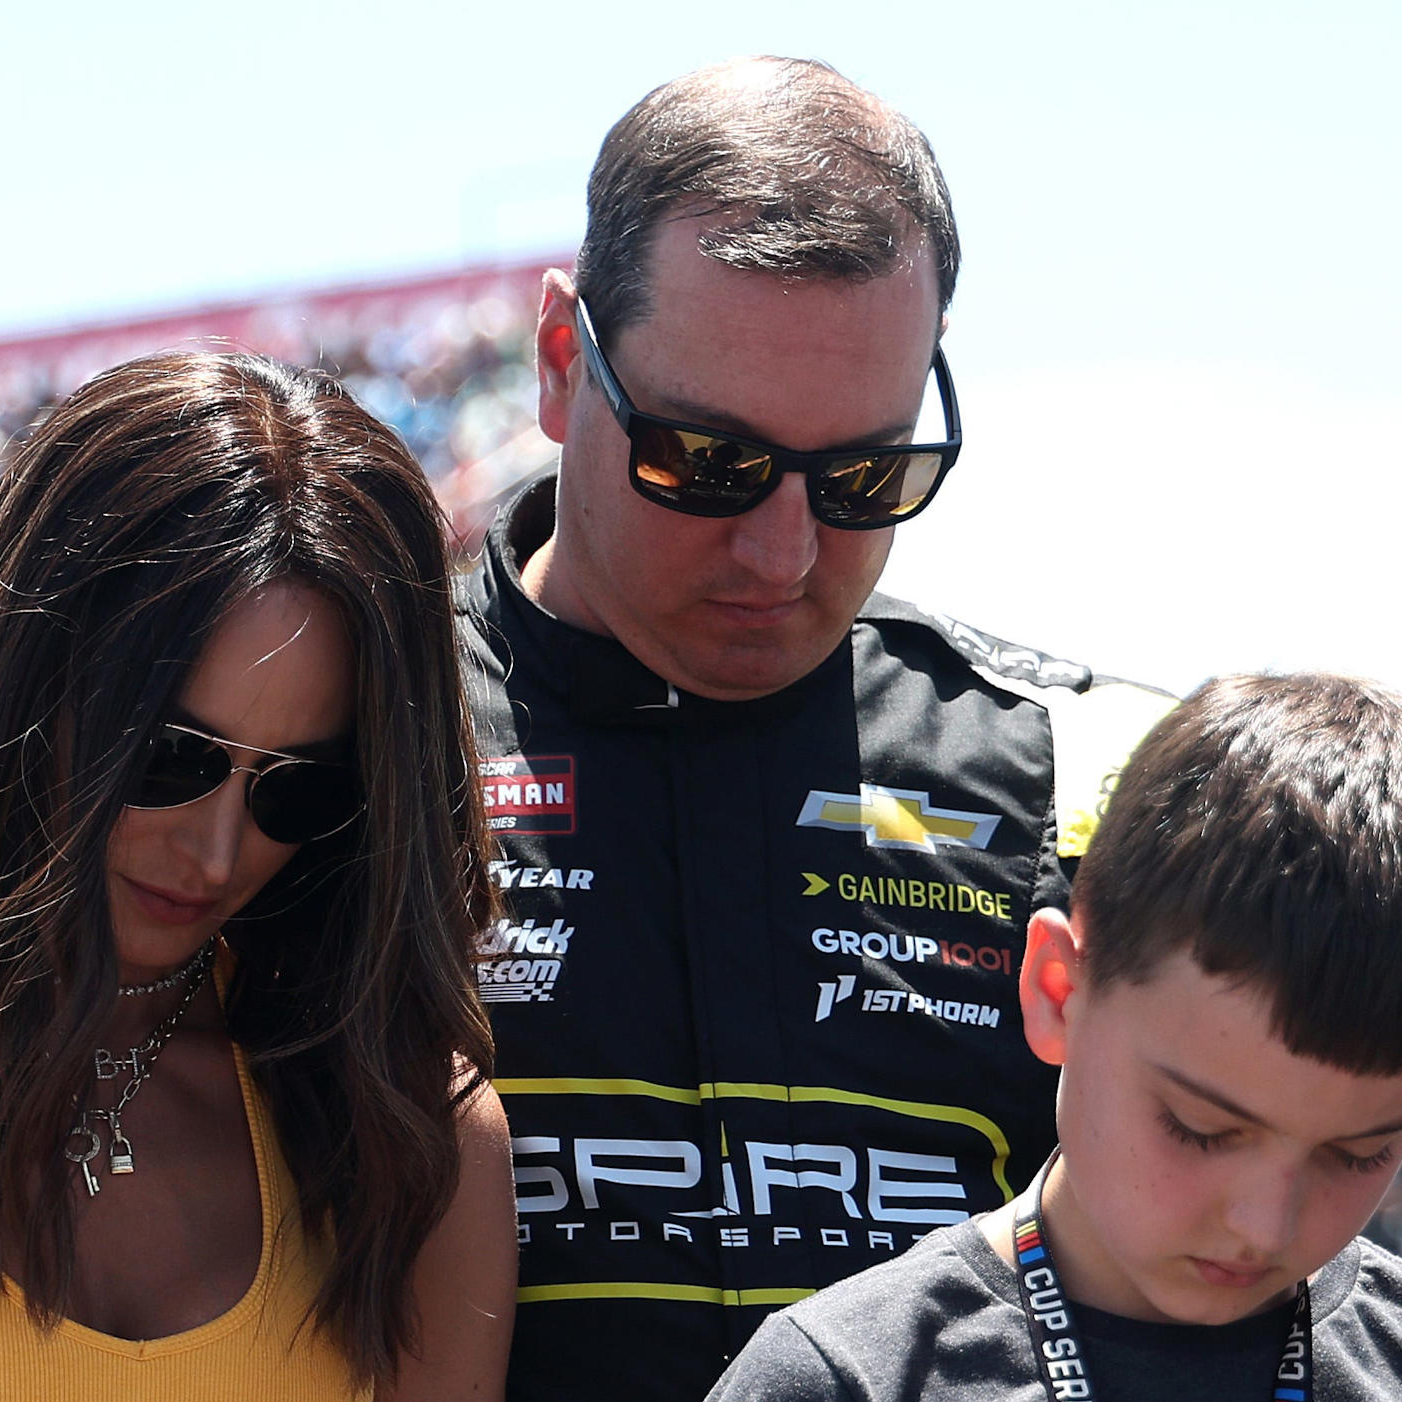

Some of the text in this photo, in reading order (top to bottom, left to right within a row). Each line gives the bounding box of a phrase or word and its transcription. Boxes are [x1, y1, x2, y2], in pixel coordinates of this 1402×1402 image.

[838, 873, 1013, 920] GAINBRIDGE
[811, 927, 1012, 975] GROUP1001
[1024, 1267, 1068, 1331] CUP
